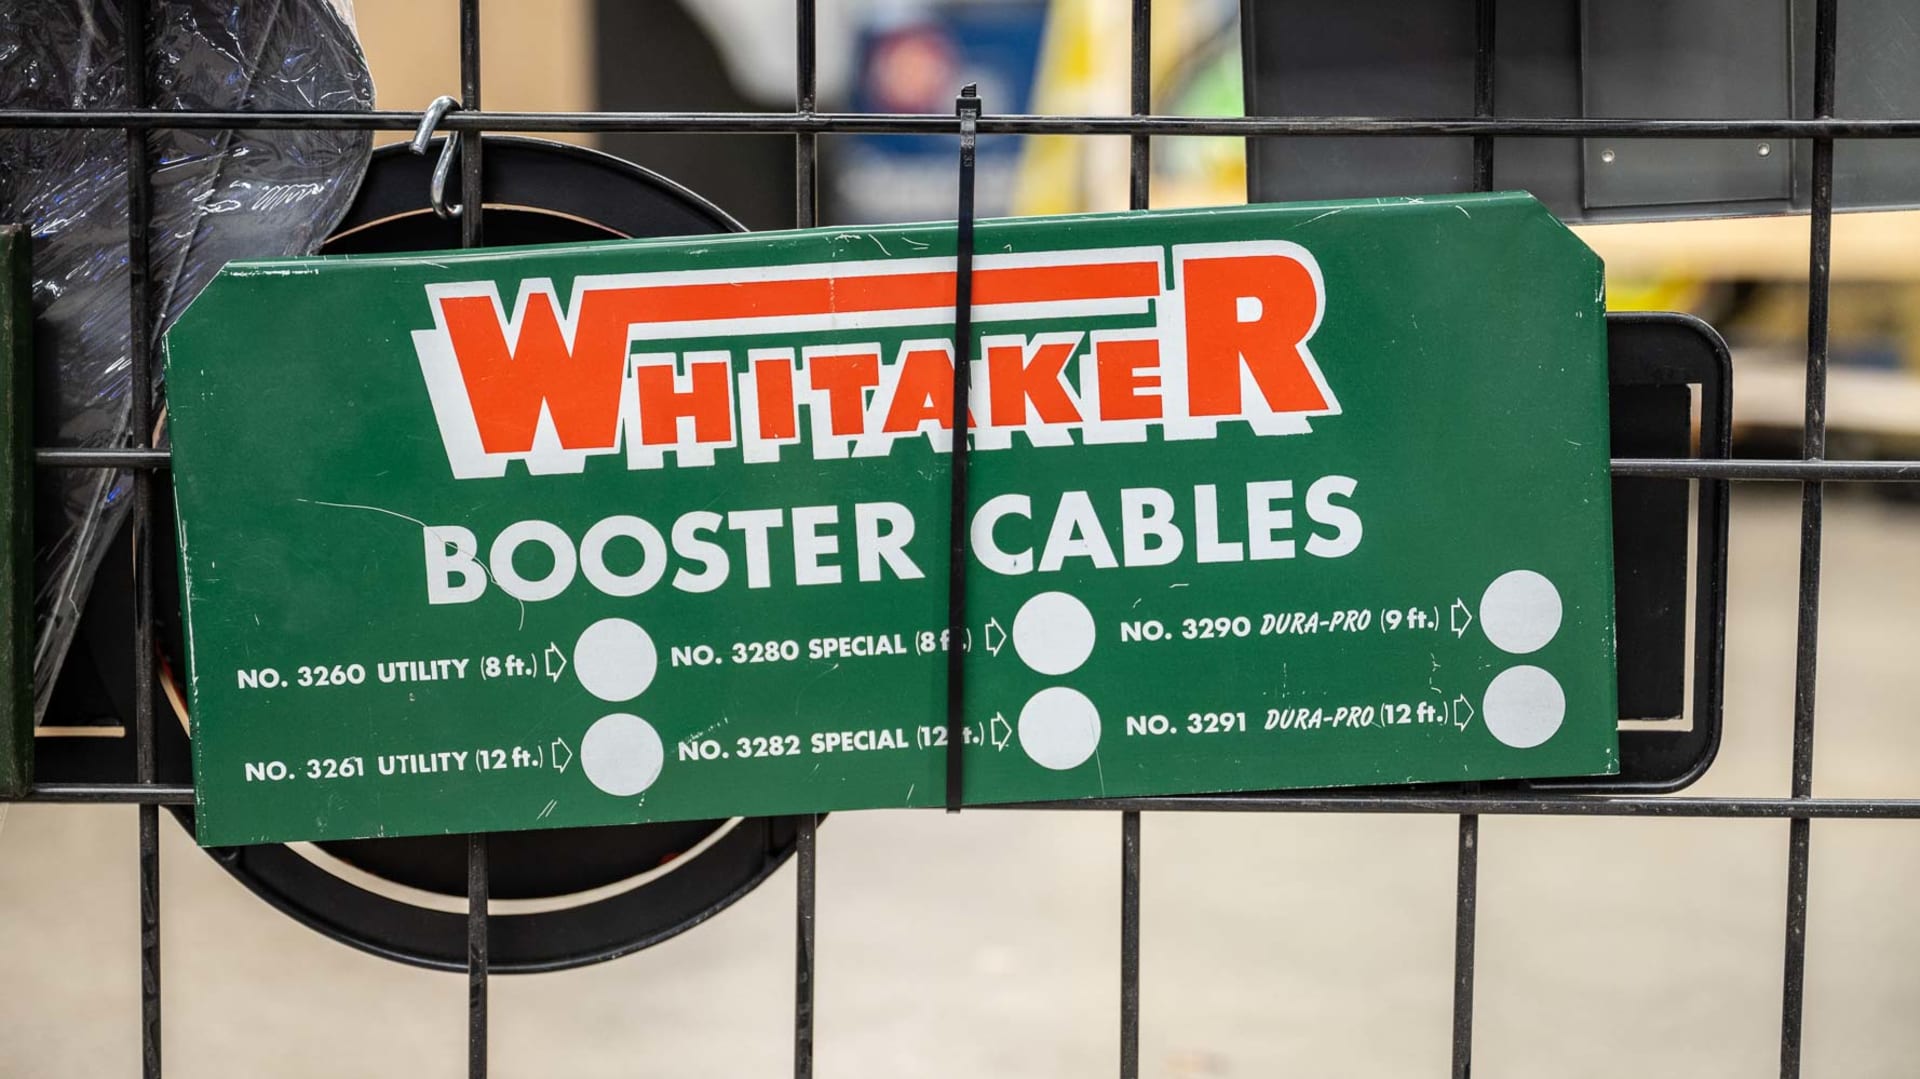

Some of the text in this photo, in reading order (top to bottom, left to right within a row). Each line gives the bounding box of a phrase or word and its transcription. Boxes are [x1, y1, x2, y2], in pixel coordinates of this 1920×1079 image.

[411, 240, 1343, 479] WHITAKER
[424, 474, 1363, 605] BOOSTER CABLES
[1120, 606, 1439, 642] NO. 3290 DURA-PRO (9 ft.)
[671, 628, 972, 667] NO. 3280 SPECIAL (8 f.)
[237, 653, 538, 689] NO. 3260 UTILITY (8 ft.)
[1126, 701, 1449, 736] NO. 3291 DURA-PRO (12 ft.)
[678, 721, 985, 761] NO. 3282 SPECIAL (12 t.)
[244, 745, 543, 782] NO. 3261 UTILITY (12 ft.)
